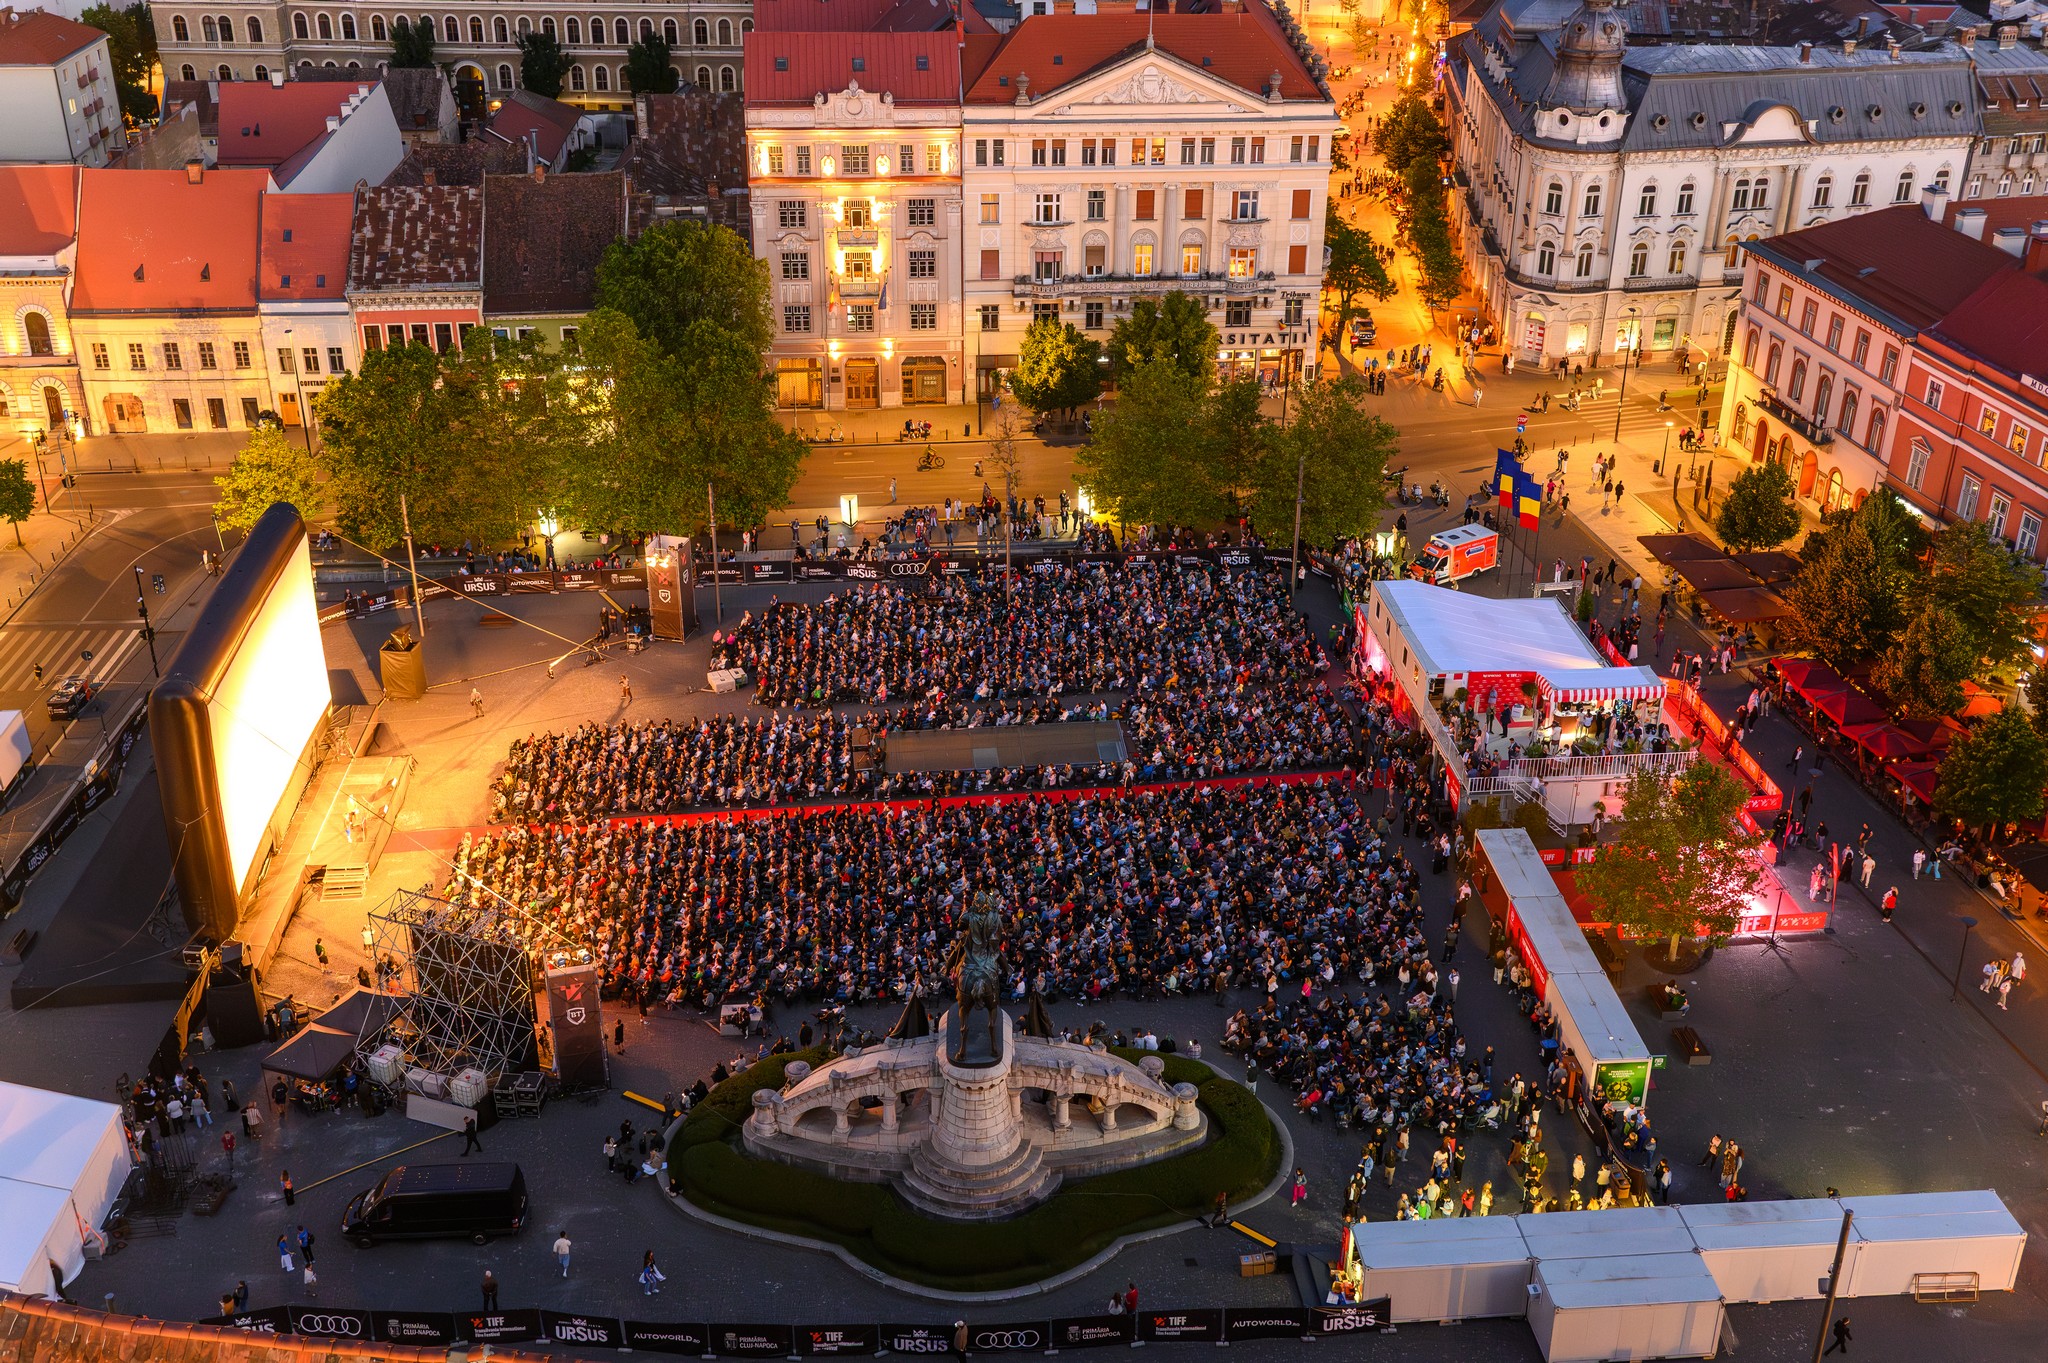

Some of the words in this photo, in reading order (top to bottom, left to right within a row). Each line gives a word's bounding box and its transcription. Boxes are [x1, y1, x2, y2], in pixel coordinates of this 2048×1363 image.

[1217, 333, 1307, 345] RSITATII
[1220, 555, 1251, 565] URSUS
[846, 568, 878, 578] URSUS
[463, 582, 496, 592] URSUS
[375, 596, 387, 604] TIFF
[27, 846, 48, 871] URSUS
[1543, 853, 1555, 861] TIFF
[1577, 849, 1596, 863] TIF
[570, 1010, 582, 1018] BT
[402, 1322, 429, 1330] PRIMĂRIA
[485, 1316, 505, 1327] TIFF
[1168, 1316, 1187, 1326] TIFF
[1323, 1315, 1376, 1331] URSUS
[403, 1329, 441, 1337] CLUJ-NAPOCA
[555, 1325, 608, 1342] URSUS
[825, 1332, 843, 1342] TIFF
[1082, 1331, 1121, 1339] CLUJ-NAPOCA
[739, 1335, 767, 1343] PRIMĂRIA
[894, 1338, 949, 1353] URSUS
